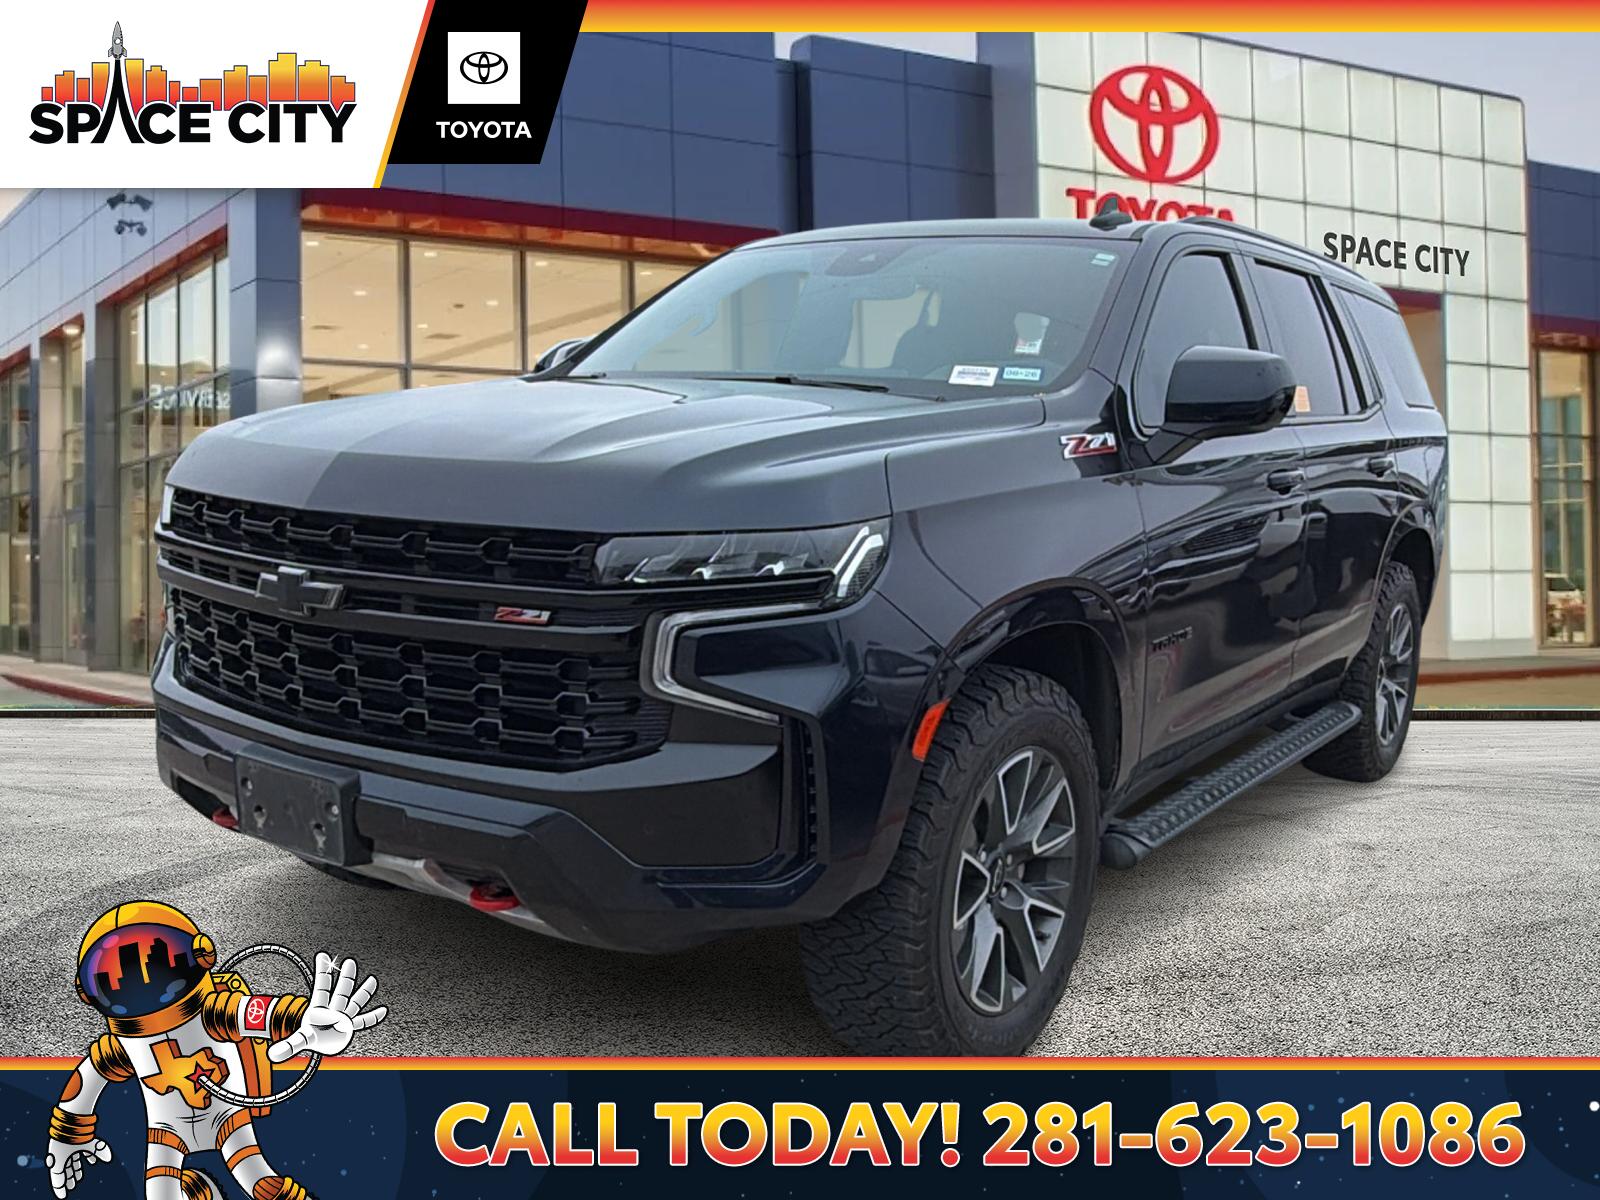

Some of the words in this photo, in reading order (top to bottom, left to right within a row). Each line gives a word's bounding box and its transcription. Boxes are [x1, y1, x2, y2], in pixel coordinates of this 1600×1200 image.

[1323, 232, 1407, 270] SPACE
[1414, 244, 1470, 277] CITY
[1060, 432, 1118, 459] Z71
